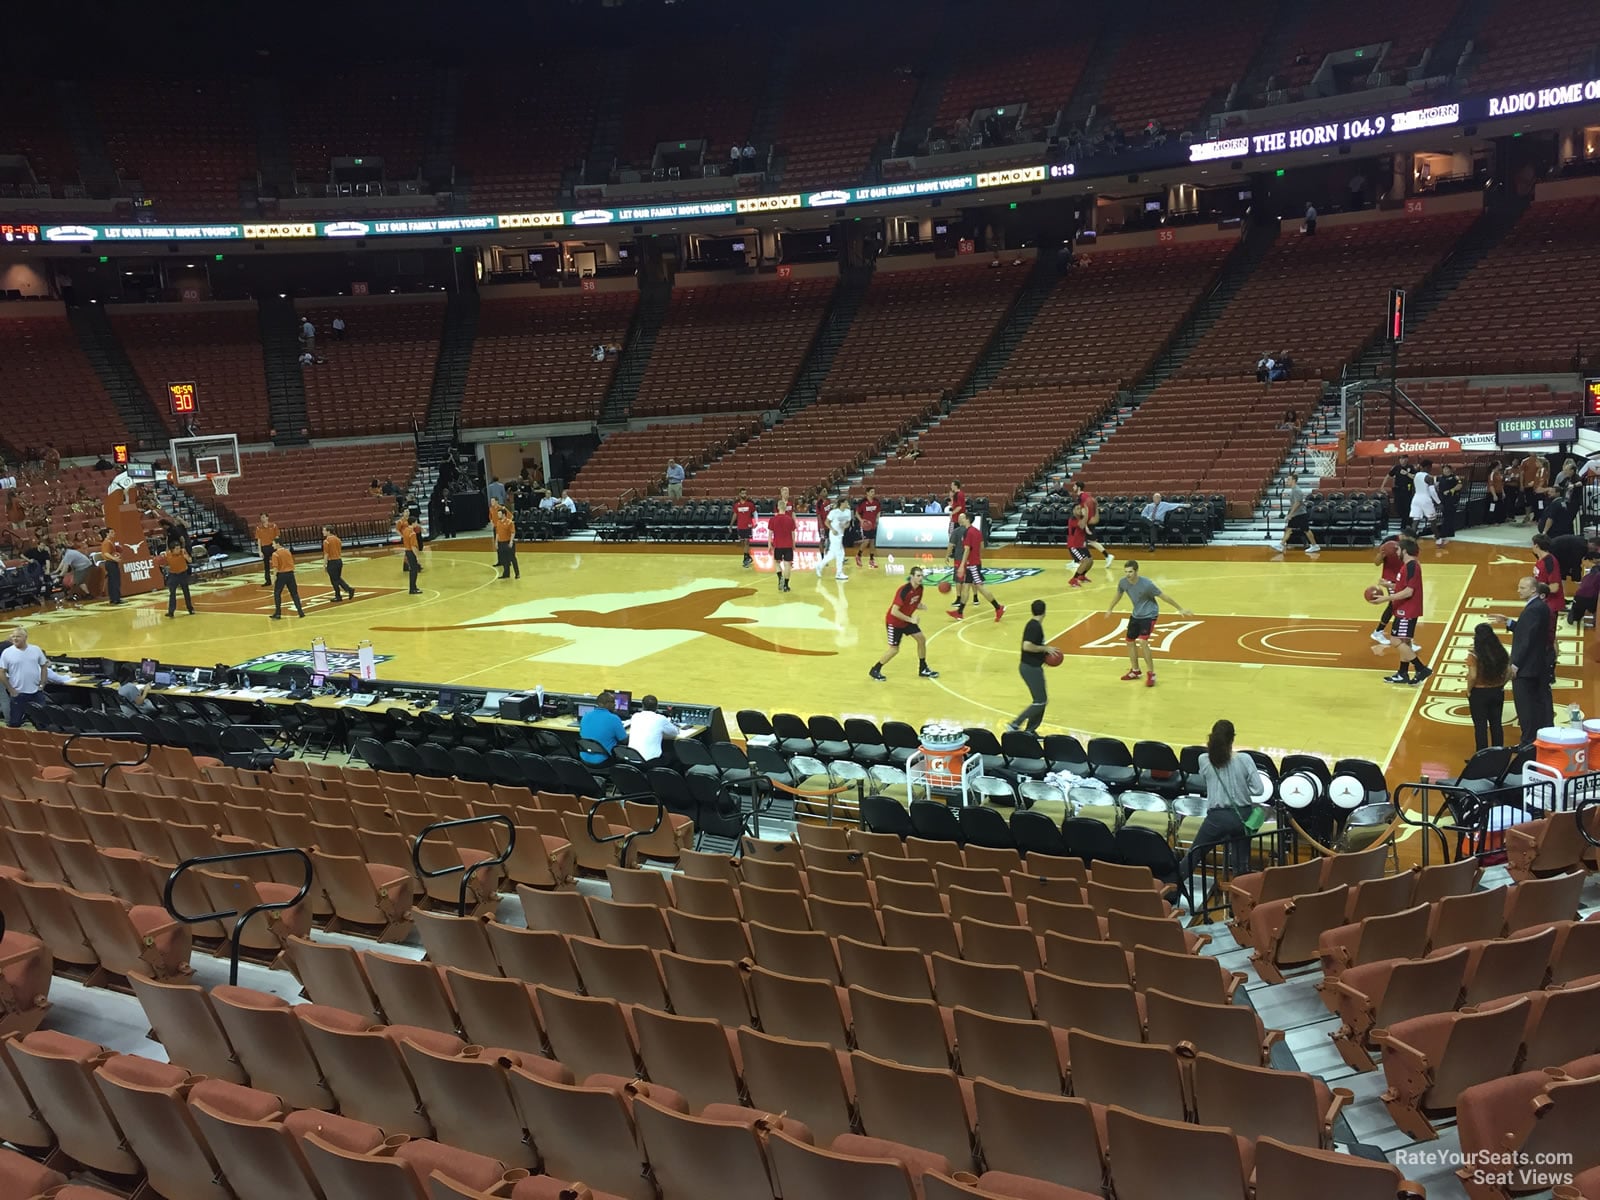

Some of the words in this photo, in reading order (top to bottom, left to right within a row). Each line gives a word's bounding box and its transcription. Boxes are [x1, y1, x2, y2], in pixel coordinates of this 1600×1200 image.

[1489, 92, 1535, 116] RADIO
[1537, 83, 1582, 108] HOME
[1253, 132, 1286, 153] THE
[1289, 124, 1338, 148] HORN
[1343, 116, 1386, 139] 104.9
[1001, 169, 1042, 181] MOVE
[856, 190, 870, 199] LET
[888, 184, 915, 196] FAMILY
[759, 198, 798, 208] MOVE
[1407, 202, 1422, 212] 34
[619, 210, 632, 219] LET
[651, 207, 677, 217] FAMILY
[522, 215, 561, 224] MOVE
[104, 228, 120, 237] LET
[142, 228, 175, 237] FAMILY
[270, 225, 312, 235] MOVE
[375, 223, 389, 232] LET
[409, 221, 437, 230] FAMILY
[175, 395, 192, 410] 30
[1501, 421, 1536, 432] LEGENDS
[1540, 418, 1573, 429] CLASSIC
[1459, 435, 1496, 444] SPALDING
[123, 560, 154, 573] MUSCLE
[131, 569, 151, 582] MILK
[1574, 750, 1585, 763] G
